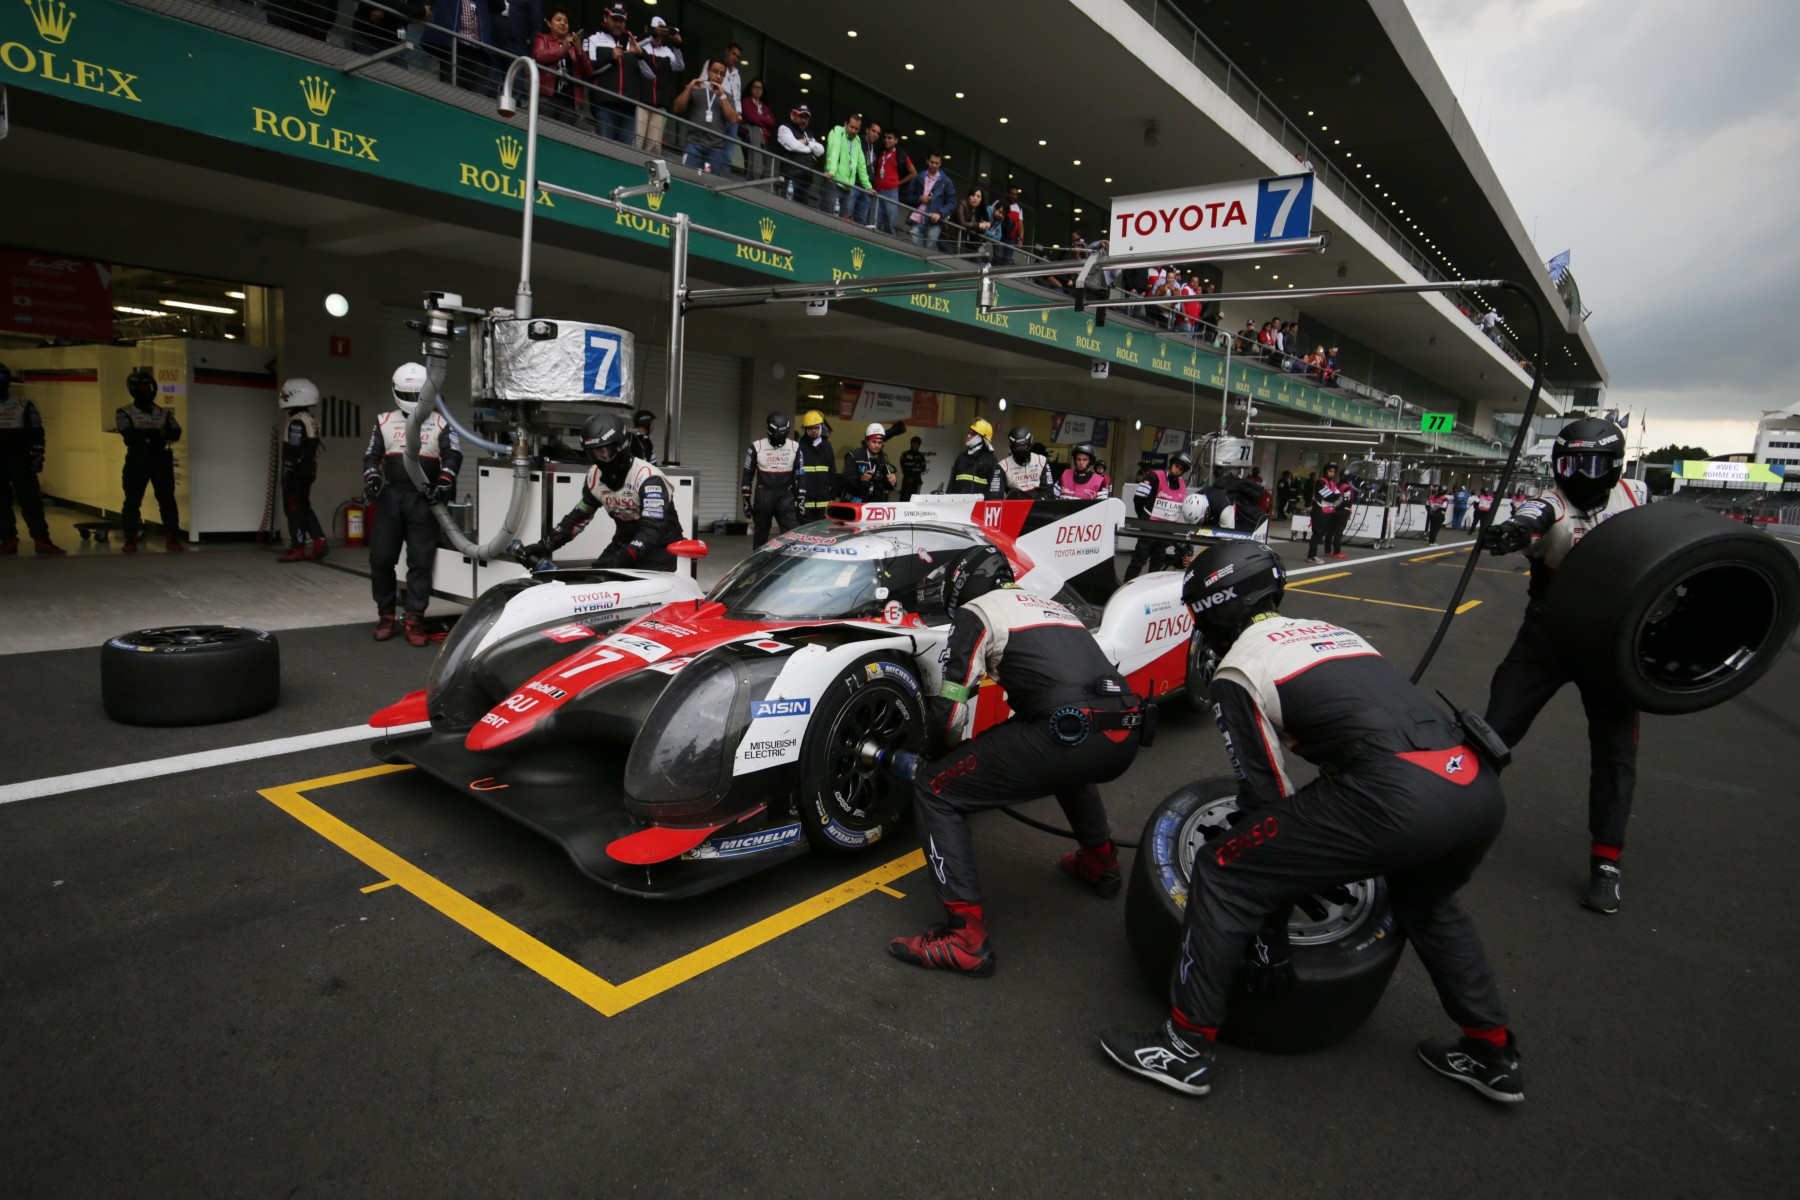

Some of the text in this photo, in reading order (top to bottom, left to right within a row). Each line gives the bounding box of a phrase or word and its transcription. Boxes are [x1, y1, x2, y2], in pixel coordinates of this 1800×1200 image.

[252, 107, 379, 162] ROLEX
[1116, 177, 1304, 238] TOYOTA 7
[736, 243, 795, 272] ROLEX
[910, 293, 950, 314] ROLEX
[975, 308, 1009, 329] ROLEX
[1029, 322, 1058, 341] ROLEX
[1075, 335, 1101, 353] ROLEX
[1116, 346, 1139, 363] ROLEX
[590, 336, 618, 391] 7
[1093, 363, 1107, 373] 12
[1152, 358, 1172, 372] ROLEX
[158, 369, 179, 382] DENSO
[1183, 365, 1201, 379] ROLEX
[864, 390, 875, 409] 77
[1428, 415, 1446, 430] 77
[1599, 434, 1619, 446] uvex
[1240, 446, 1251, 461] 77
[1703, 471, 1750, 480] #6HMEXICO
[1716, 464, 1740, 472] #WEC
[1156, 499, 1169, 508] PIT
[866, 507, 897, 521] ZENT
[984, 506, 1001, 527] HY
[1055, 524, 1102, 545] DENSO
[787, 544, 858, 556] HYBRID
[1054, 547, 1100, 558] TOYOTA HYBRID
[949, 569, 970, 610] uvex
[571, 591, 621, 605] TOYOTA 7
[1191, 586, 1239, 614] uvex
[574, 601, 613, 613] HYBRID
[889, 606, 898, 620] E
[547, 624, 590, 639] HY
[1145, 614, 1192, 645] DENSO
[559, 649, 625, 679] 7
[884, 664, 917, 691] MICHELIN
[525, 681, 557, 694] Mobil
[757, 701, 807, 715] AISIN
[480, 713, 510, 729] ZENT
[750, 738, 797, 751] MITSUBISHI
[744, 748, 786, 760] ELECTRIC
[929, 753, 977, 795] DENSO
[719, 827, 799, 850] MICHELIN
[827, 824, 864, 845] MICHELIN
[1215, 815, 1278, 867] DENSO
